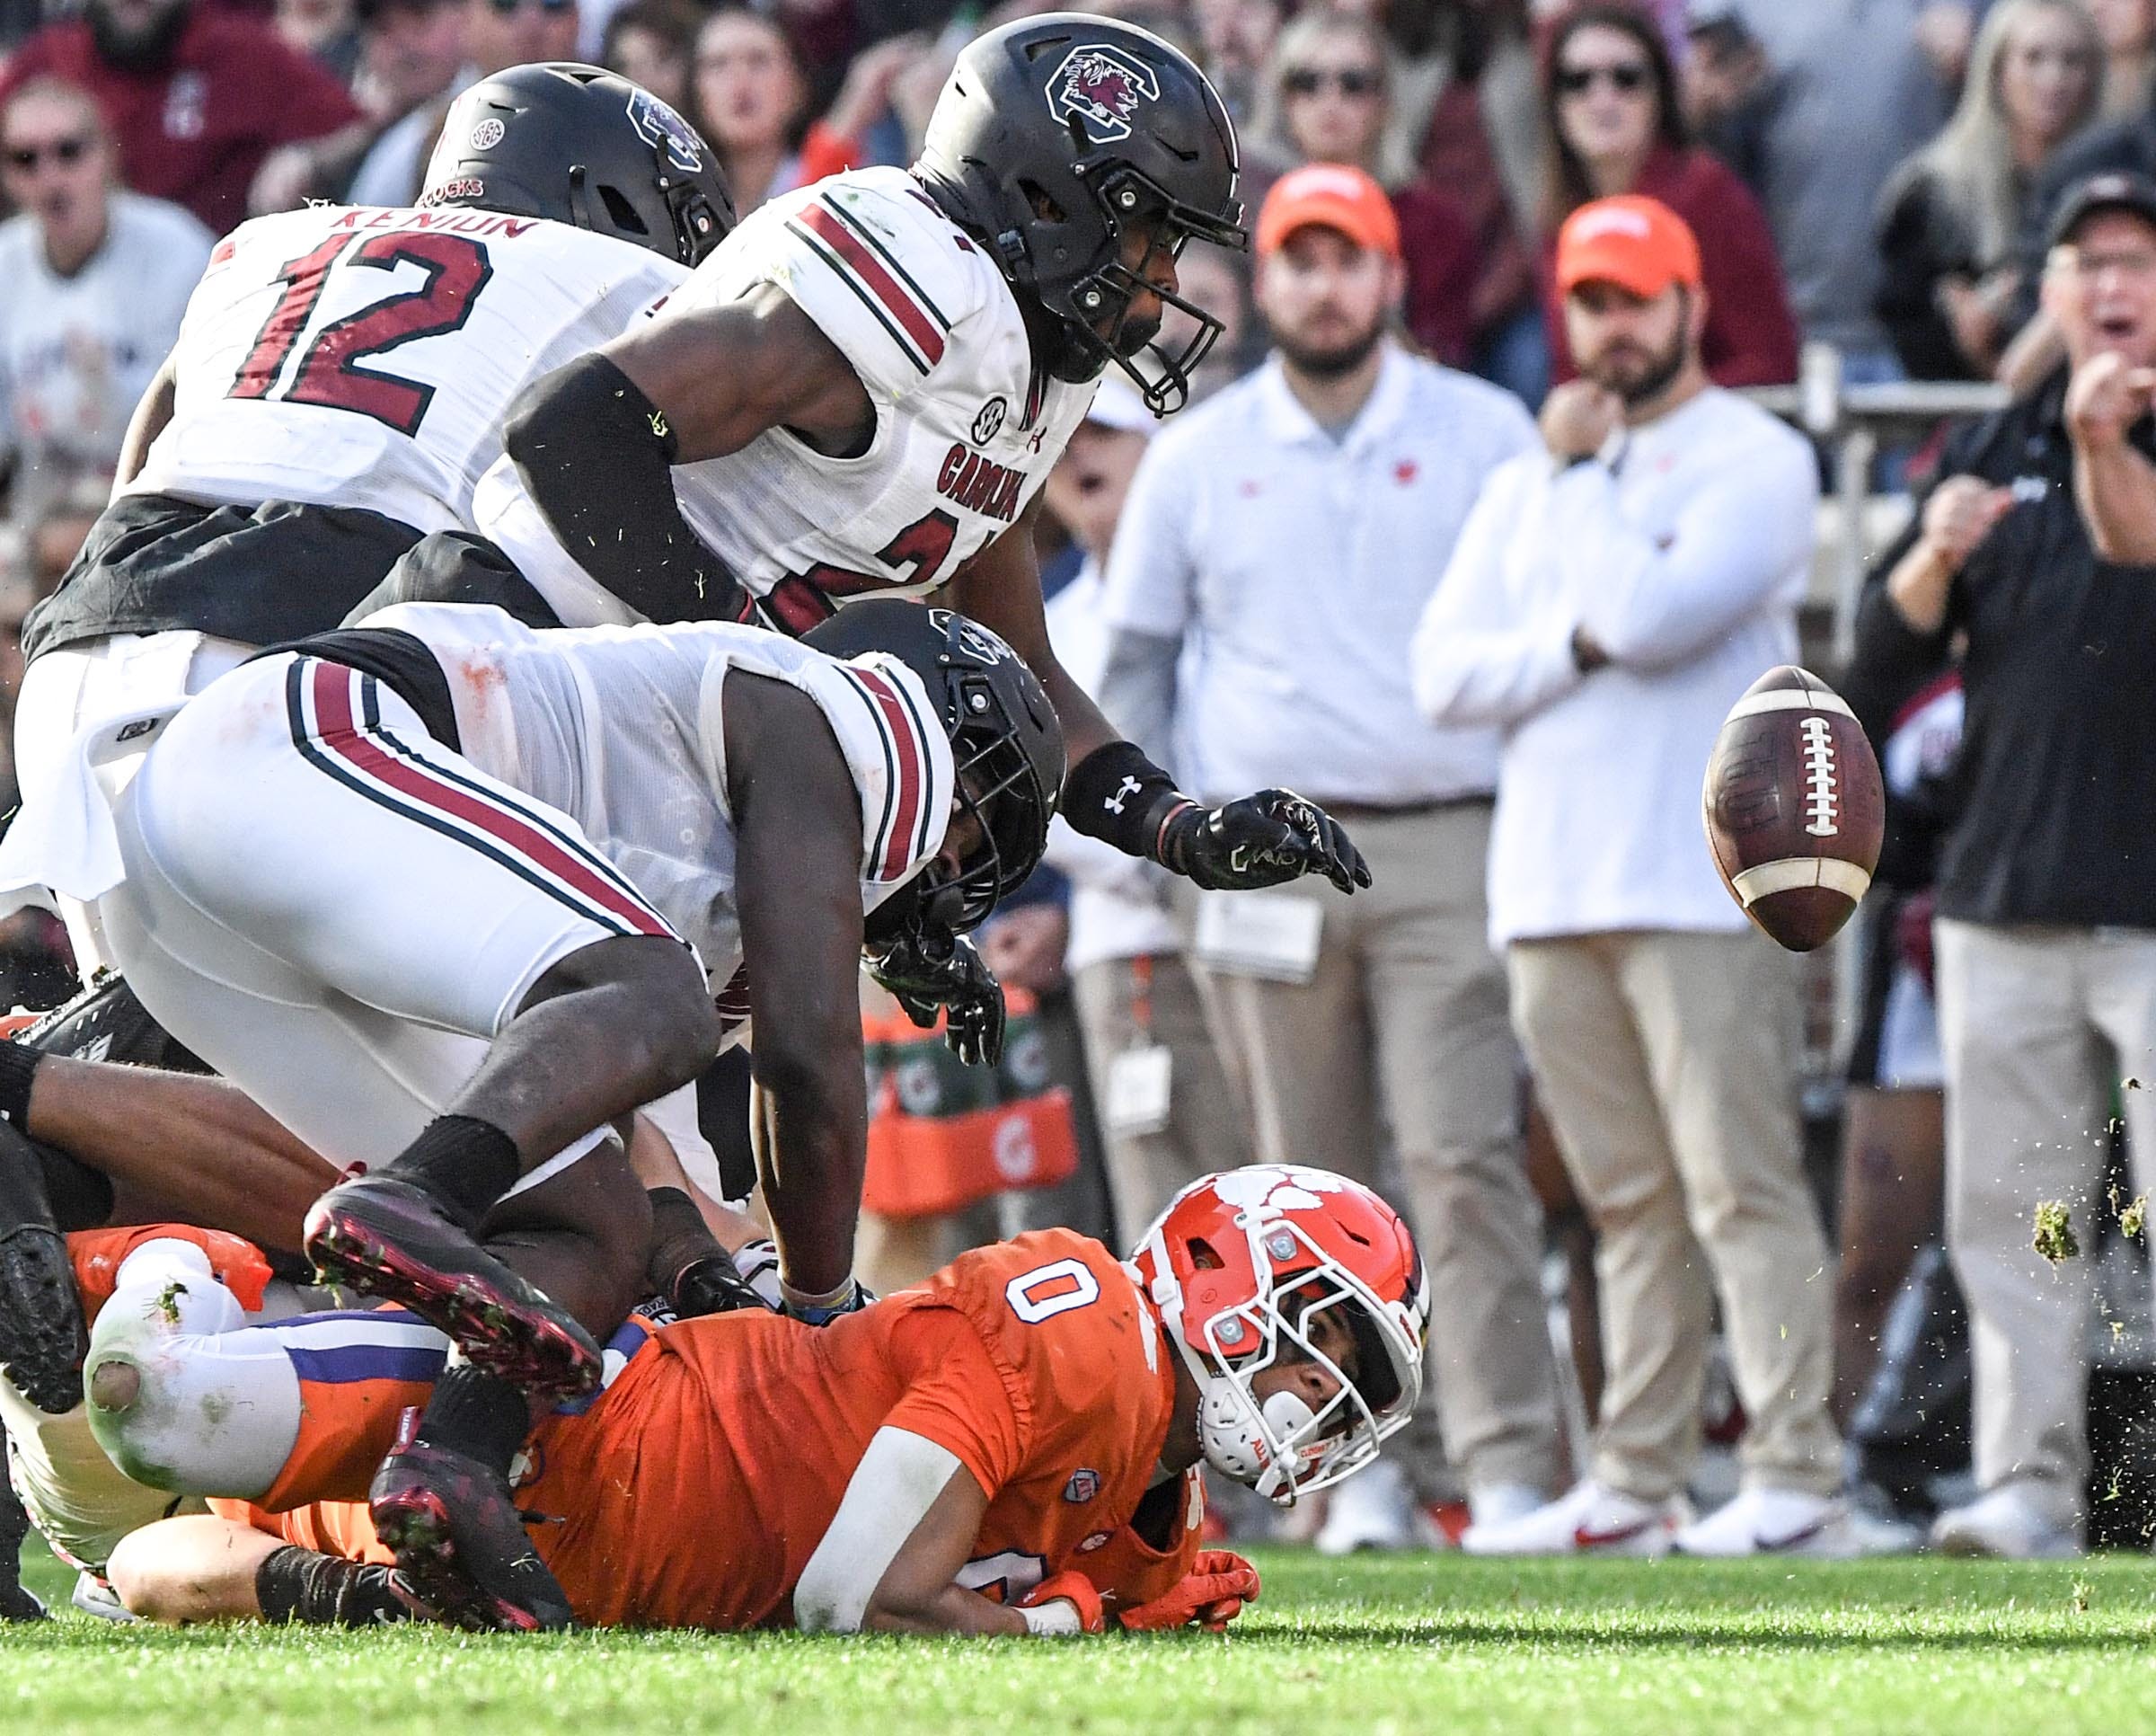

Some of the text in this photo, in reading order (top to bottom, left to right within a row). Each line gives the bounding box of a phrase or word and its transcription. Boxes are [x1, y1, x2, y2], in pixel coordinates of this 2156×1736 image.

[472, 120, 504, 149] SEC
[225, 230, 494, 438] 12
[1005, 1257, 1100, 1325] 0
